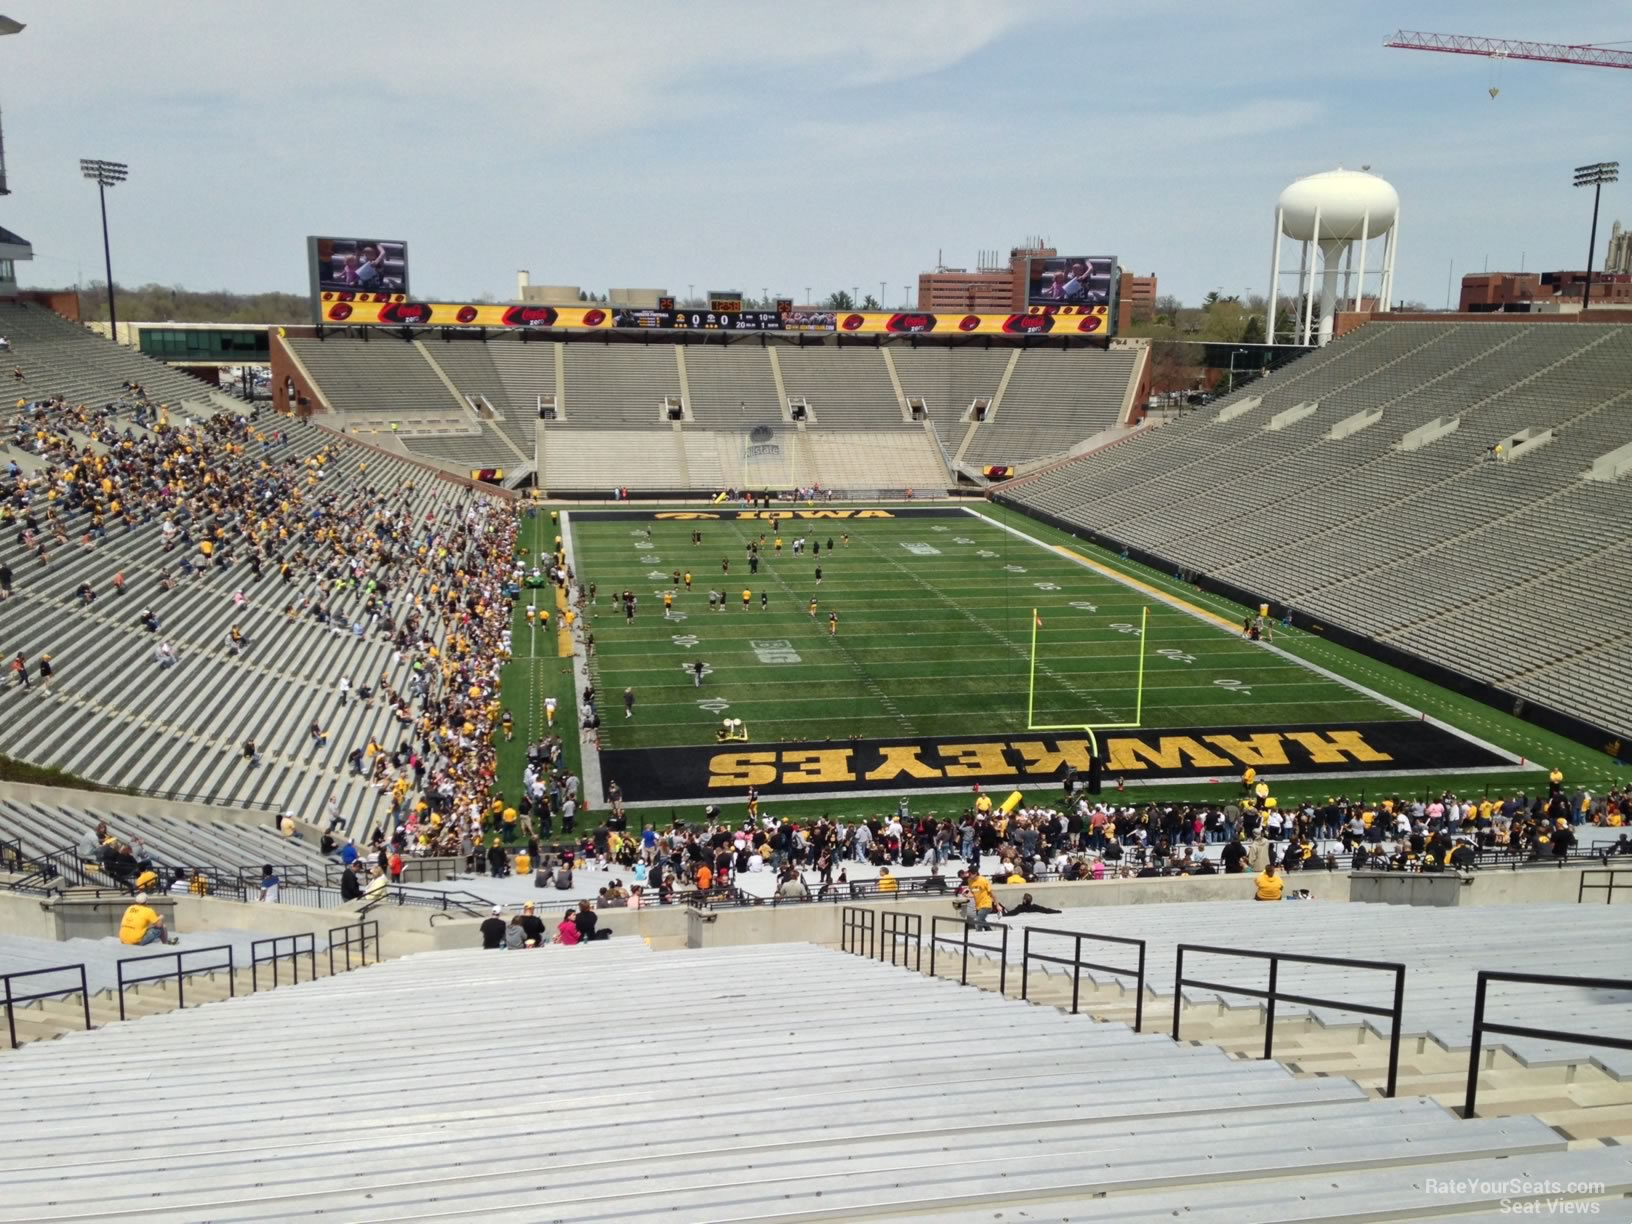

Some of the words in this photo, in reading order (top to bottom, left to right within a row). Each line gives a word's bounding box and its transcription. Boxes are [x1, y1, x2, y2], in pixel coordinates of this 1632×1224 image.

[692, 314, 700, 325] 0
[721, 314, 729, 325] 0
[736, 510, 895, 519] IOWA
[1213, 679, 1252, 691] 10
[707, 730, 1394, 788] HAWKEYES
